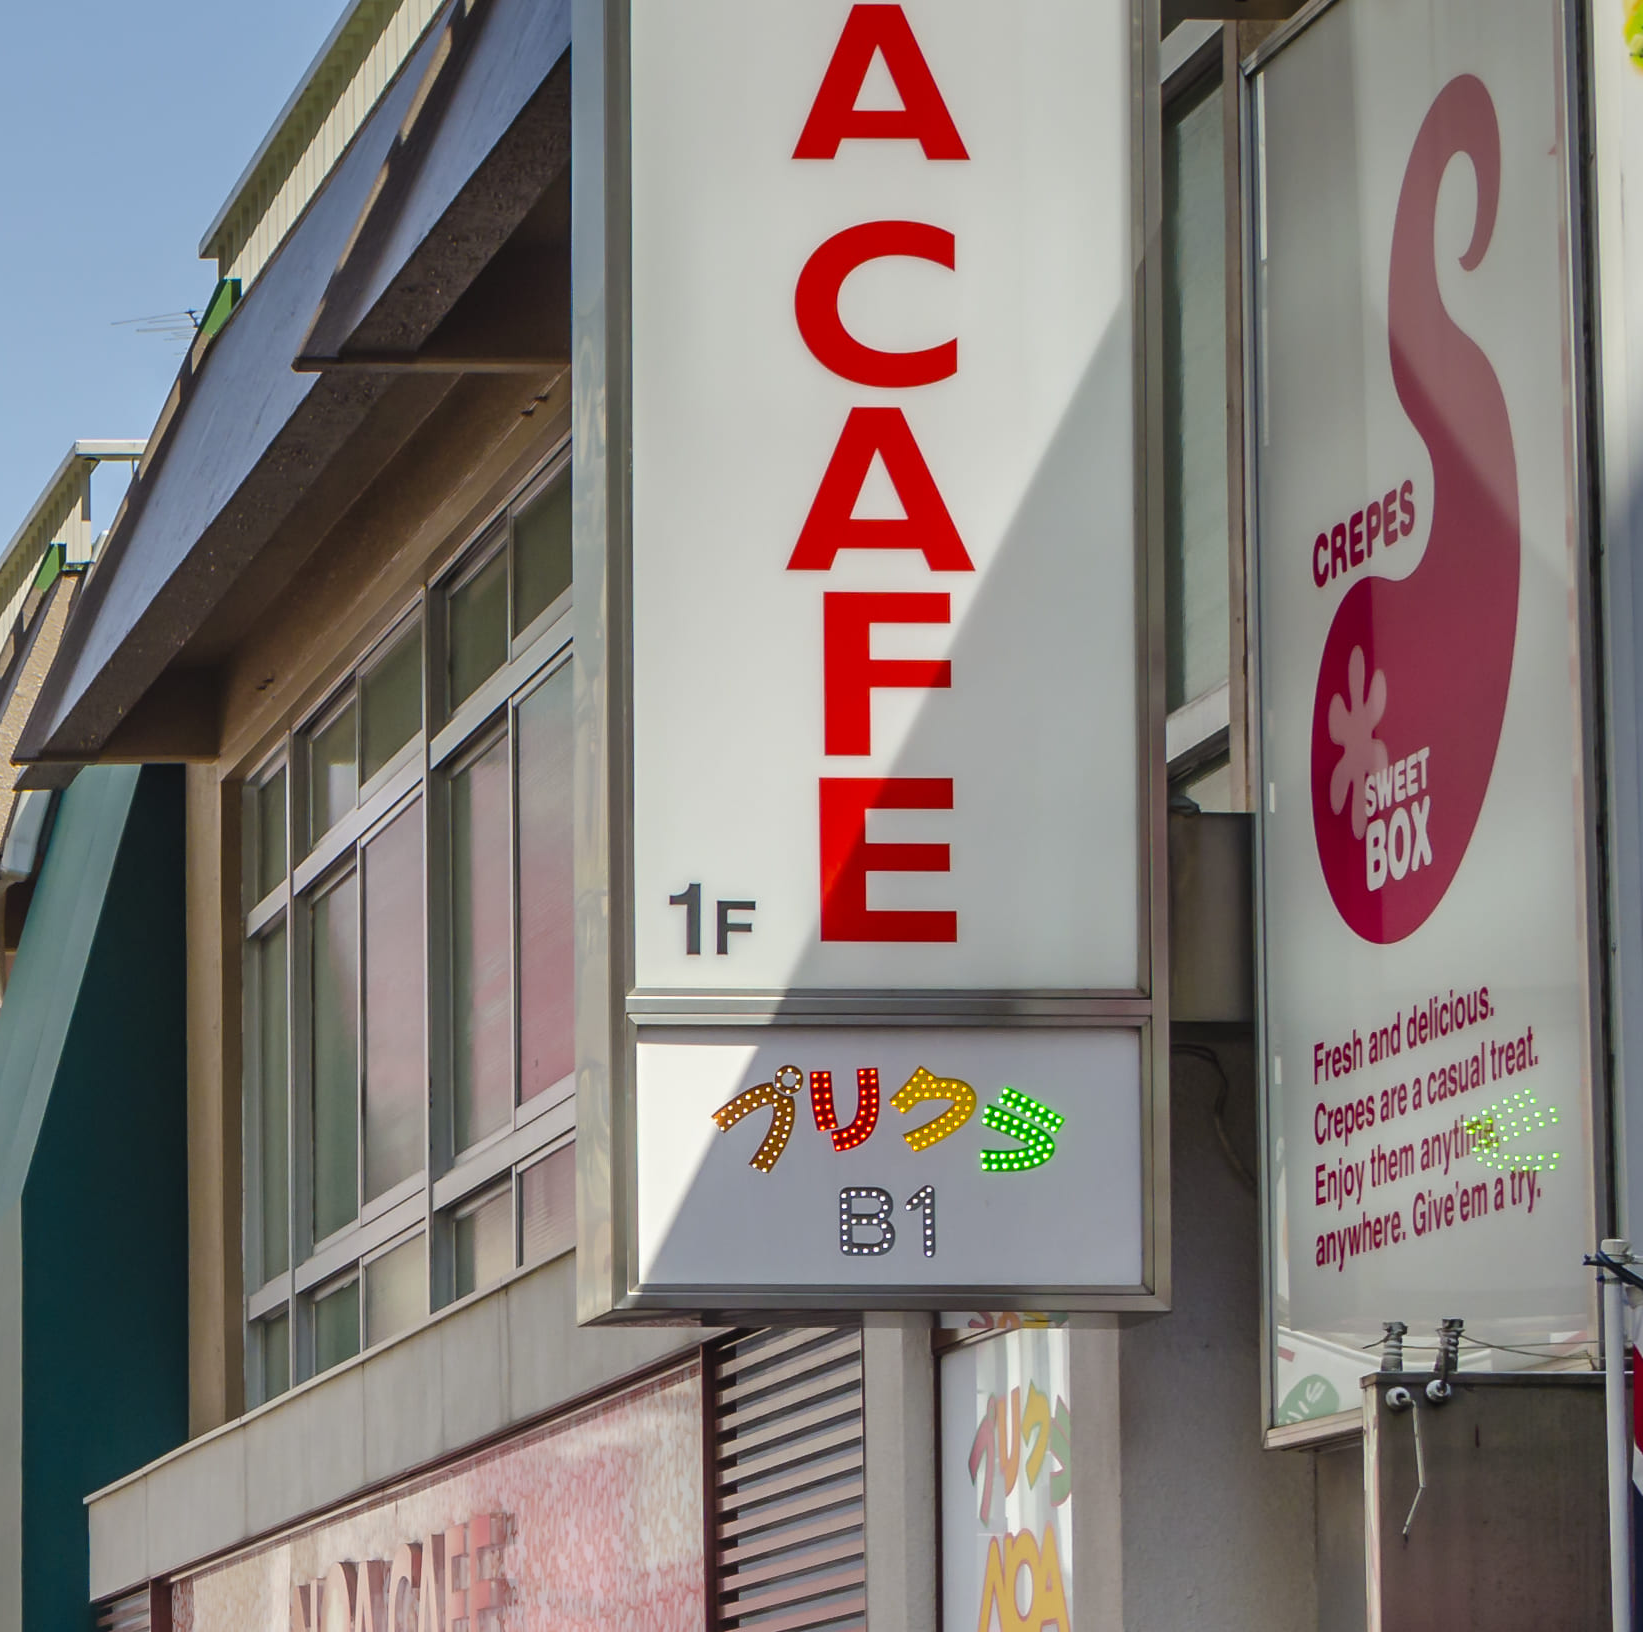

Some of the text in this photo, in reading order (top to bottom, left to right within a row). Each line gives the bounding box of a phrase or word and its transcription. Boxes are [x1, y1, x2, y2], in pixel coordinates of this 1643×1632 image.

[1312, 480, 1415, 588] CREPES
[1364, 747, 1430, 818] SWEET
[1365, 795, 1433, 892] BOX
[668, 882, 757, 956] 1F
[1314, 986, 1495, 1085] Fresh and delicious.
[711, 1064, 1064, 1174] プリクラ
[1314, 1026, 1539, 1146] Crepes are a casual treat.
[839, 1185, 936, 1258] B1
[1315, 1160, 1365, 1210] Enjoy
[1371, 1137, 1416, 1189] them
[1315, 1210, 1406, 1272] anywhere.
[1494, 1175, 1504, 1201] a
[1510, 1168, 1542, 1215] try.
